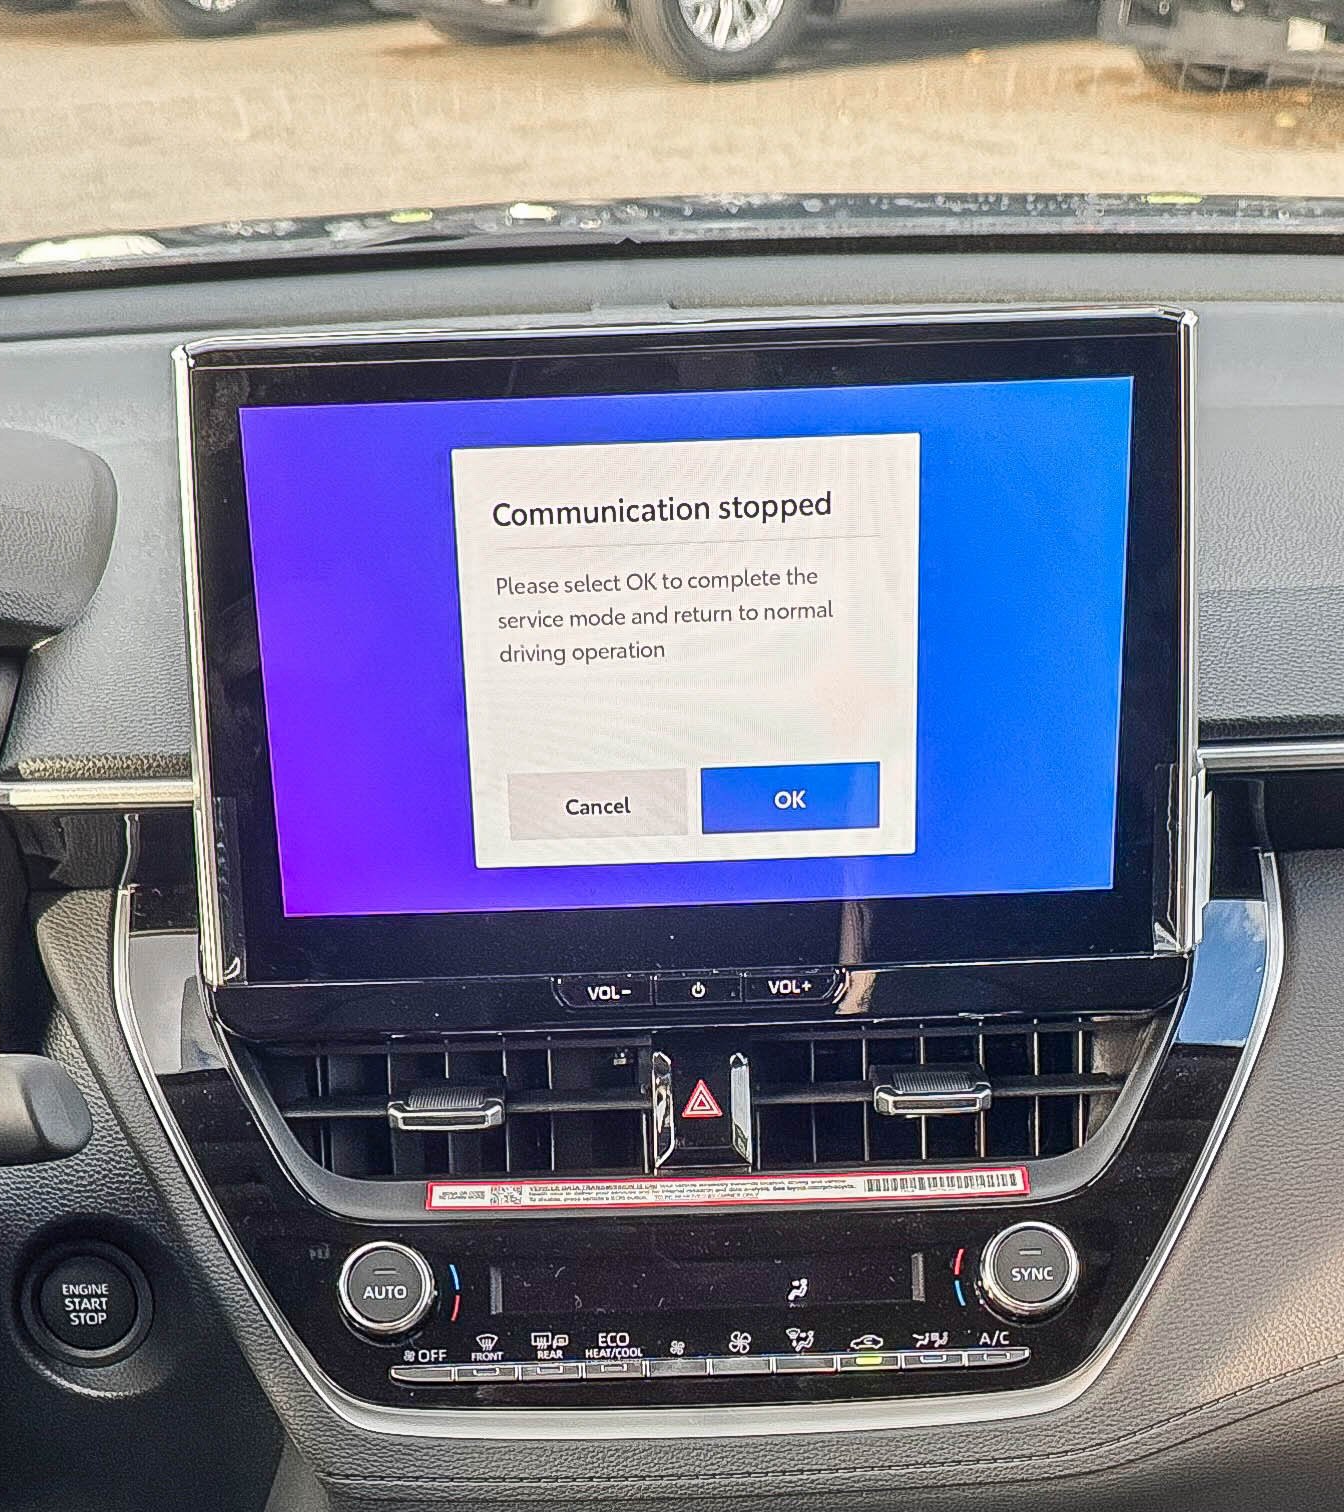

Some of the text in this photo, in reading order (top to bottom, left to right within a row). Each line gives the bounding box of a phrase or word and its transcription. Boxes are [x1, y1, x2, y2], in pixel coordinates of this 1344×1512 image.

[492, 491, 832, 527] Communication stopped
[496, 567, 818, 596] Please select OK to complete the
[497, 600, 834, 629] service mode and return to normal
[499, 642, 665, 666] driving operation
[565, 797, 631, 816] Cancel
[774, 791, 806, 810] OK
[1010, 1265, 1054, 1282] SYNC
[62, 1283, 110, 1297] ENGINE
[362, 1285, 407, 1300] AUTO
[64, 1298, 108, 1311] START
[70, 1311, 107, 1326] STOP
[598, 1332, 629, 1346] ECO
[979, 1331, 1010, 1346] A/C
[417, 1349, 447, 1362] OFF
[471, 1351, 504, 1362] FRONT
[537, 1350, 563, 1360] REAR
[585, 1348, 643, 1360] HEAT/COOL
